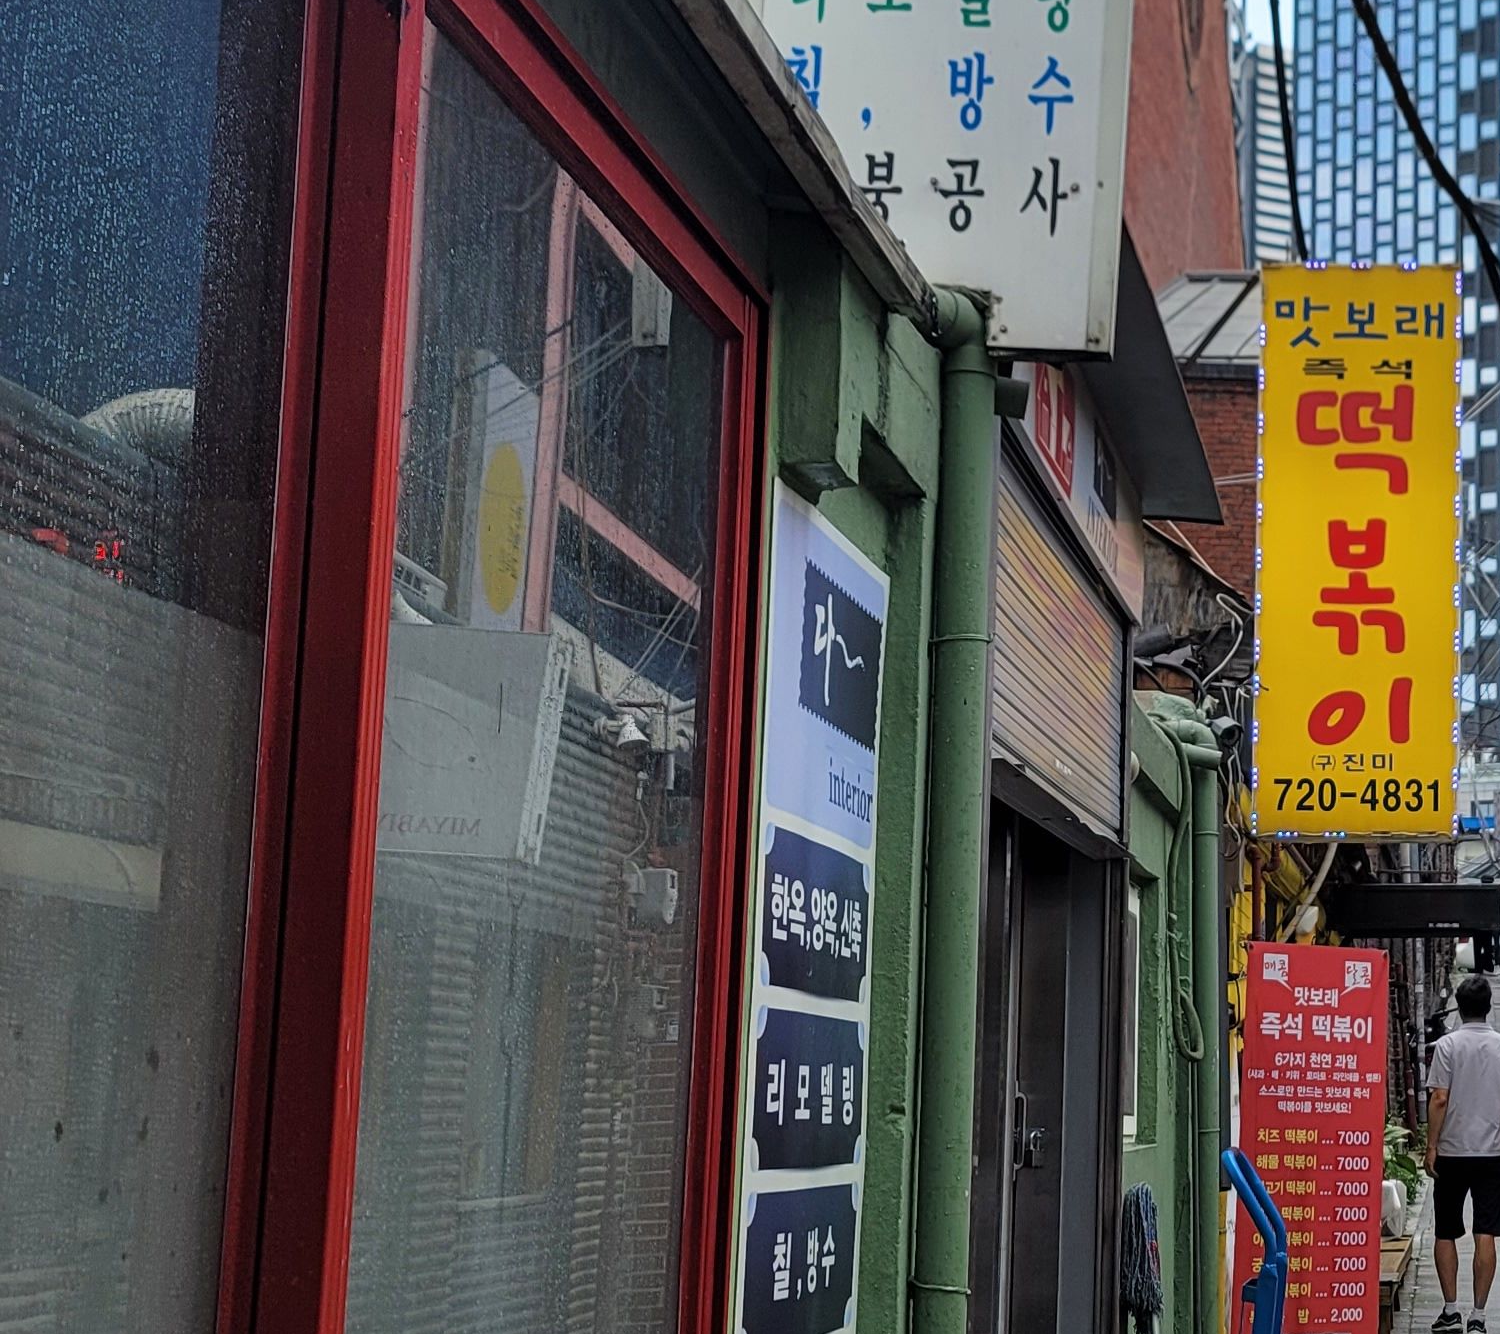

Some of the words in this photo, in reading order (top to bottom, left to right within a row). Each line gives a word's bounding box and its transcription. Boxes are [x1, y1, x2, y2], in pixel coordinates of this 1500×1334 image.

[1275, 297, 1445, 348] 맛보래
[1302, 358, 1413, 380] 즉석
[828, 757, 873, 823] interior
[1273, 778, 1440, 812] 720-4831
[1294, 987, 1339, 1008] 맛보래
[1260, 1012, 1303, 1041] 즉석
[1312, 1014, 1372, 1044] 떡볶이
[1275, 1052, 1305, 1067] 6가지
[1309, 1052, 1332, 1068] 천연
[1334, 1054, 1357, 1069] 과일
[1257, 1128, 1280, 1143] 치즈
[1284, 1129, 1318, 1144] 떡볶이
[1337, 1131, 1370, 1145] 7000
[1256, 1154, 1279, 1169] 해물
[1283, 1155, 1317, 1170] 떡볶이
[1337, 1157, 1369, 1170] 7000
[1262, 1180, 1284, 1195] 고기
[1286, 1180, 1316, 1195] 떡볶이
[1336, 1182, 1368, 1196] 7000
[1281, 1206, 1315, 1221] 떡볶이
[1334, 1207, 1367, 1221] 7000
[1333, 1231, 1366, 1246] 7000
[1287, 1257, 1312, 1272] 볶이
[1333, 1257, 1366, 1271] 7000
[1286, 1283, 1311, 1298] 볶이
[1332, 1283, 1365, 1297] 7000
[1331, 1308, 1363, 1323] 2,000
